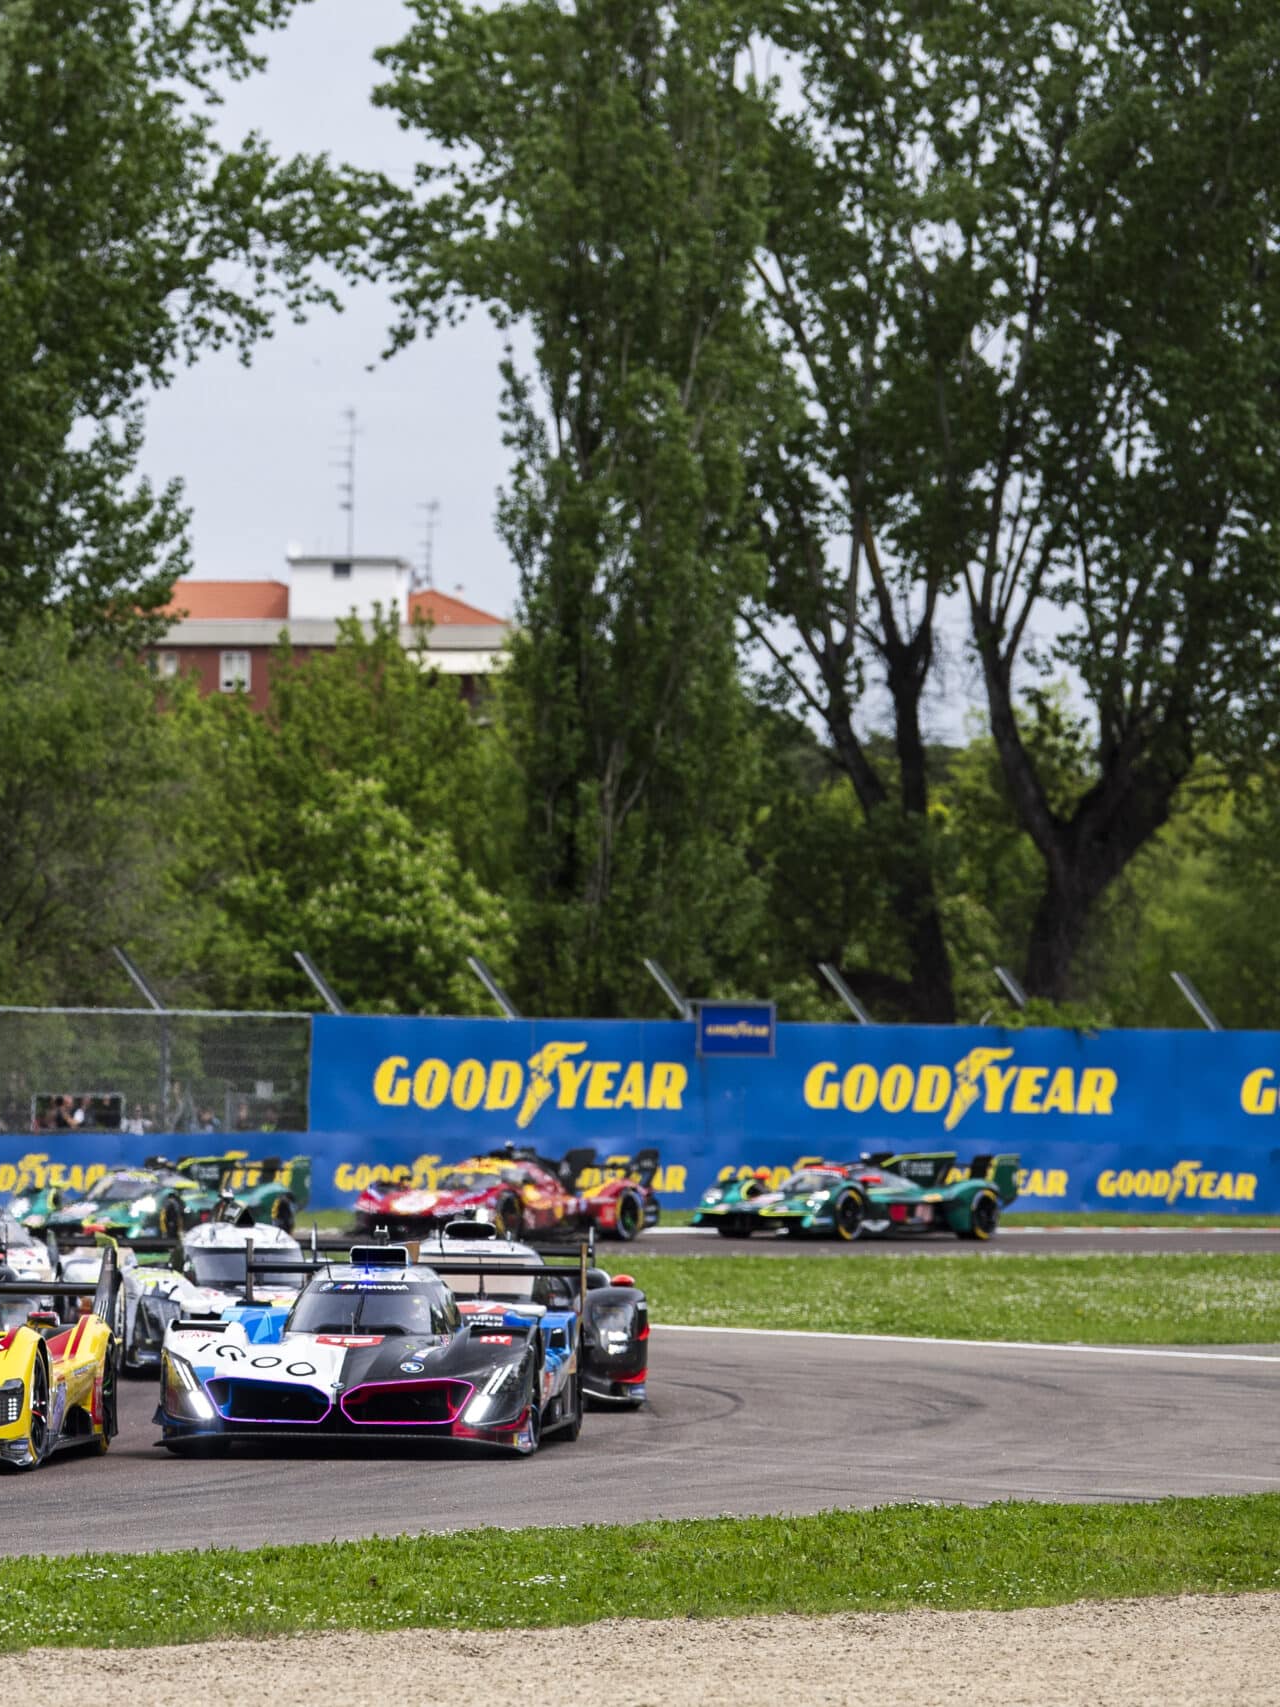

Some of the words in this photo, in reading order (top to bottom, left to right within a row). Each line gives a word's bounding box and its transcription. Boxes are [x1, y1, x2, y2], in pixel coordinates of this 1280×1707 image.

[373, 1049, 688, 1116] GOODYEAR
[804, 1054, 1119, 1119] GOODYEAR
[1097, 1166, 1258, 1201] GOODYEAR
[481, 1335, 510, 1344] HY
